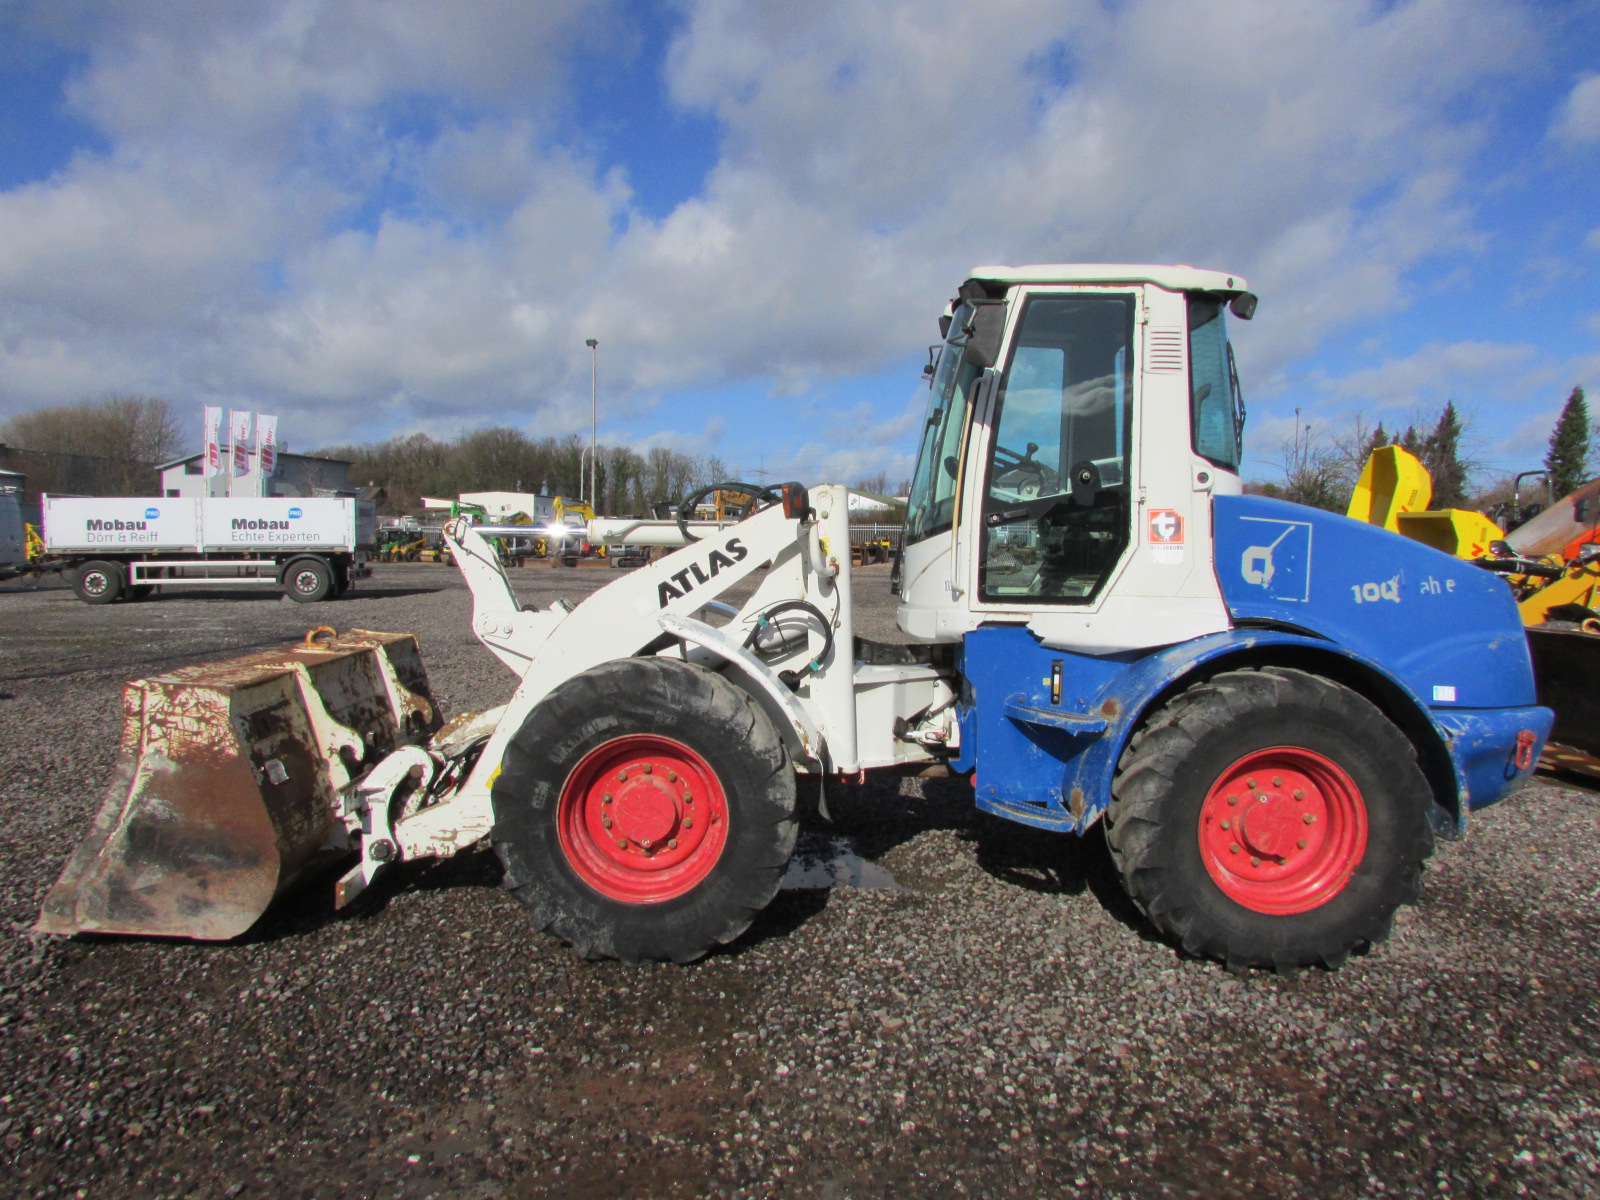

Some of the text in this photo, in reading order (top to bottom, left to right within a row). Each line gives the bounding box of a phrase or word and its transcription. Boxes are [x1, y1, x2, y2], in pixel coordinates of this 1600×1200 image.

[86, 519, 147, 531] Mobau
[231, 518, 290, 530] Mobau
[87, 532, 159, 543] Dörr & Reiff
[231, 531, 320, 543] Echte Experten
[657, 537, 748, 610] ATLAS
